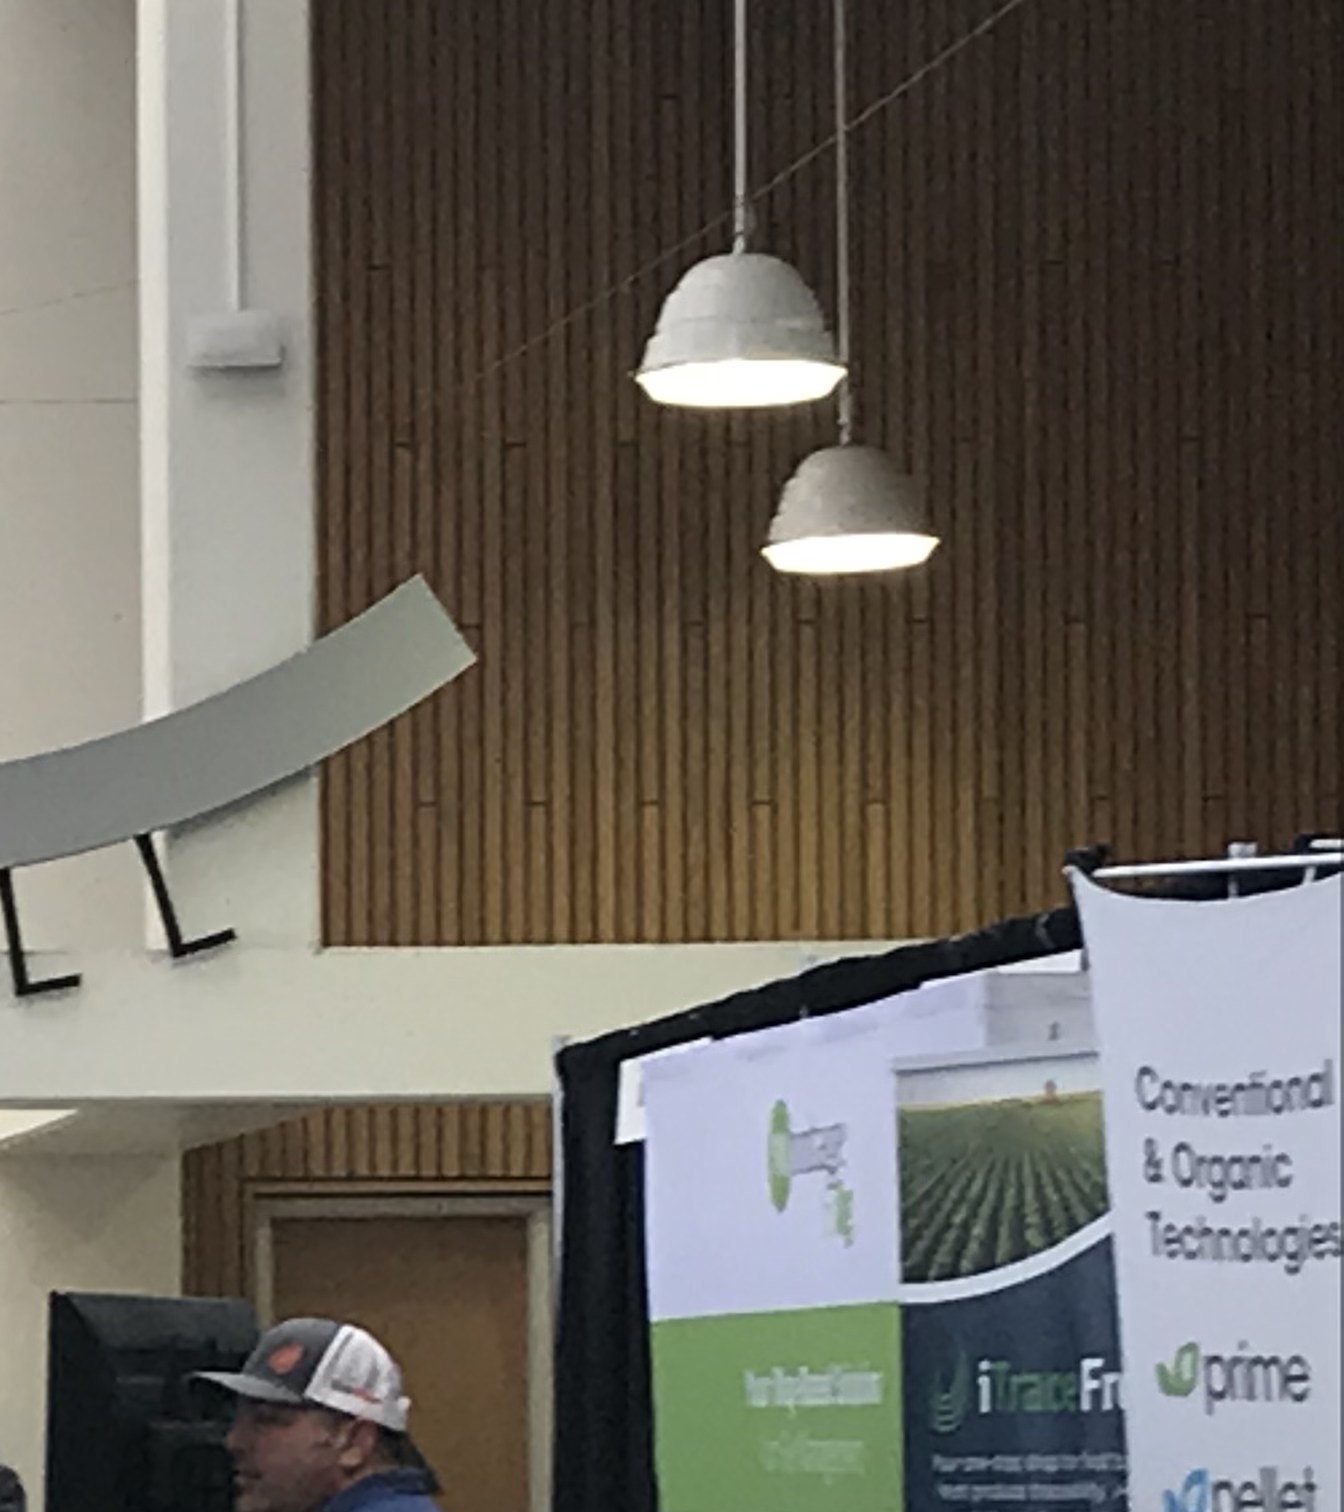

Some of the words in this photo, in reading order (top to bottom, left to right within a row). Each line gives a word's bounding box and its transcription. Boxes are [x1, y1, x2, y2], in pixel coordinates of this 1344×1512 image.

[1135, 1059, 1334, 1116] Conventional
[1144, 1137, 1164, 1184] &
[1171, 1142, 1294, 1203] Organic
[1204, 1340, 1311, 1416] prime
